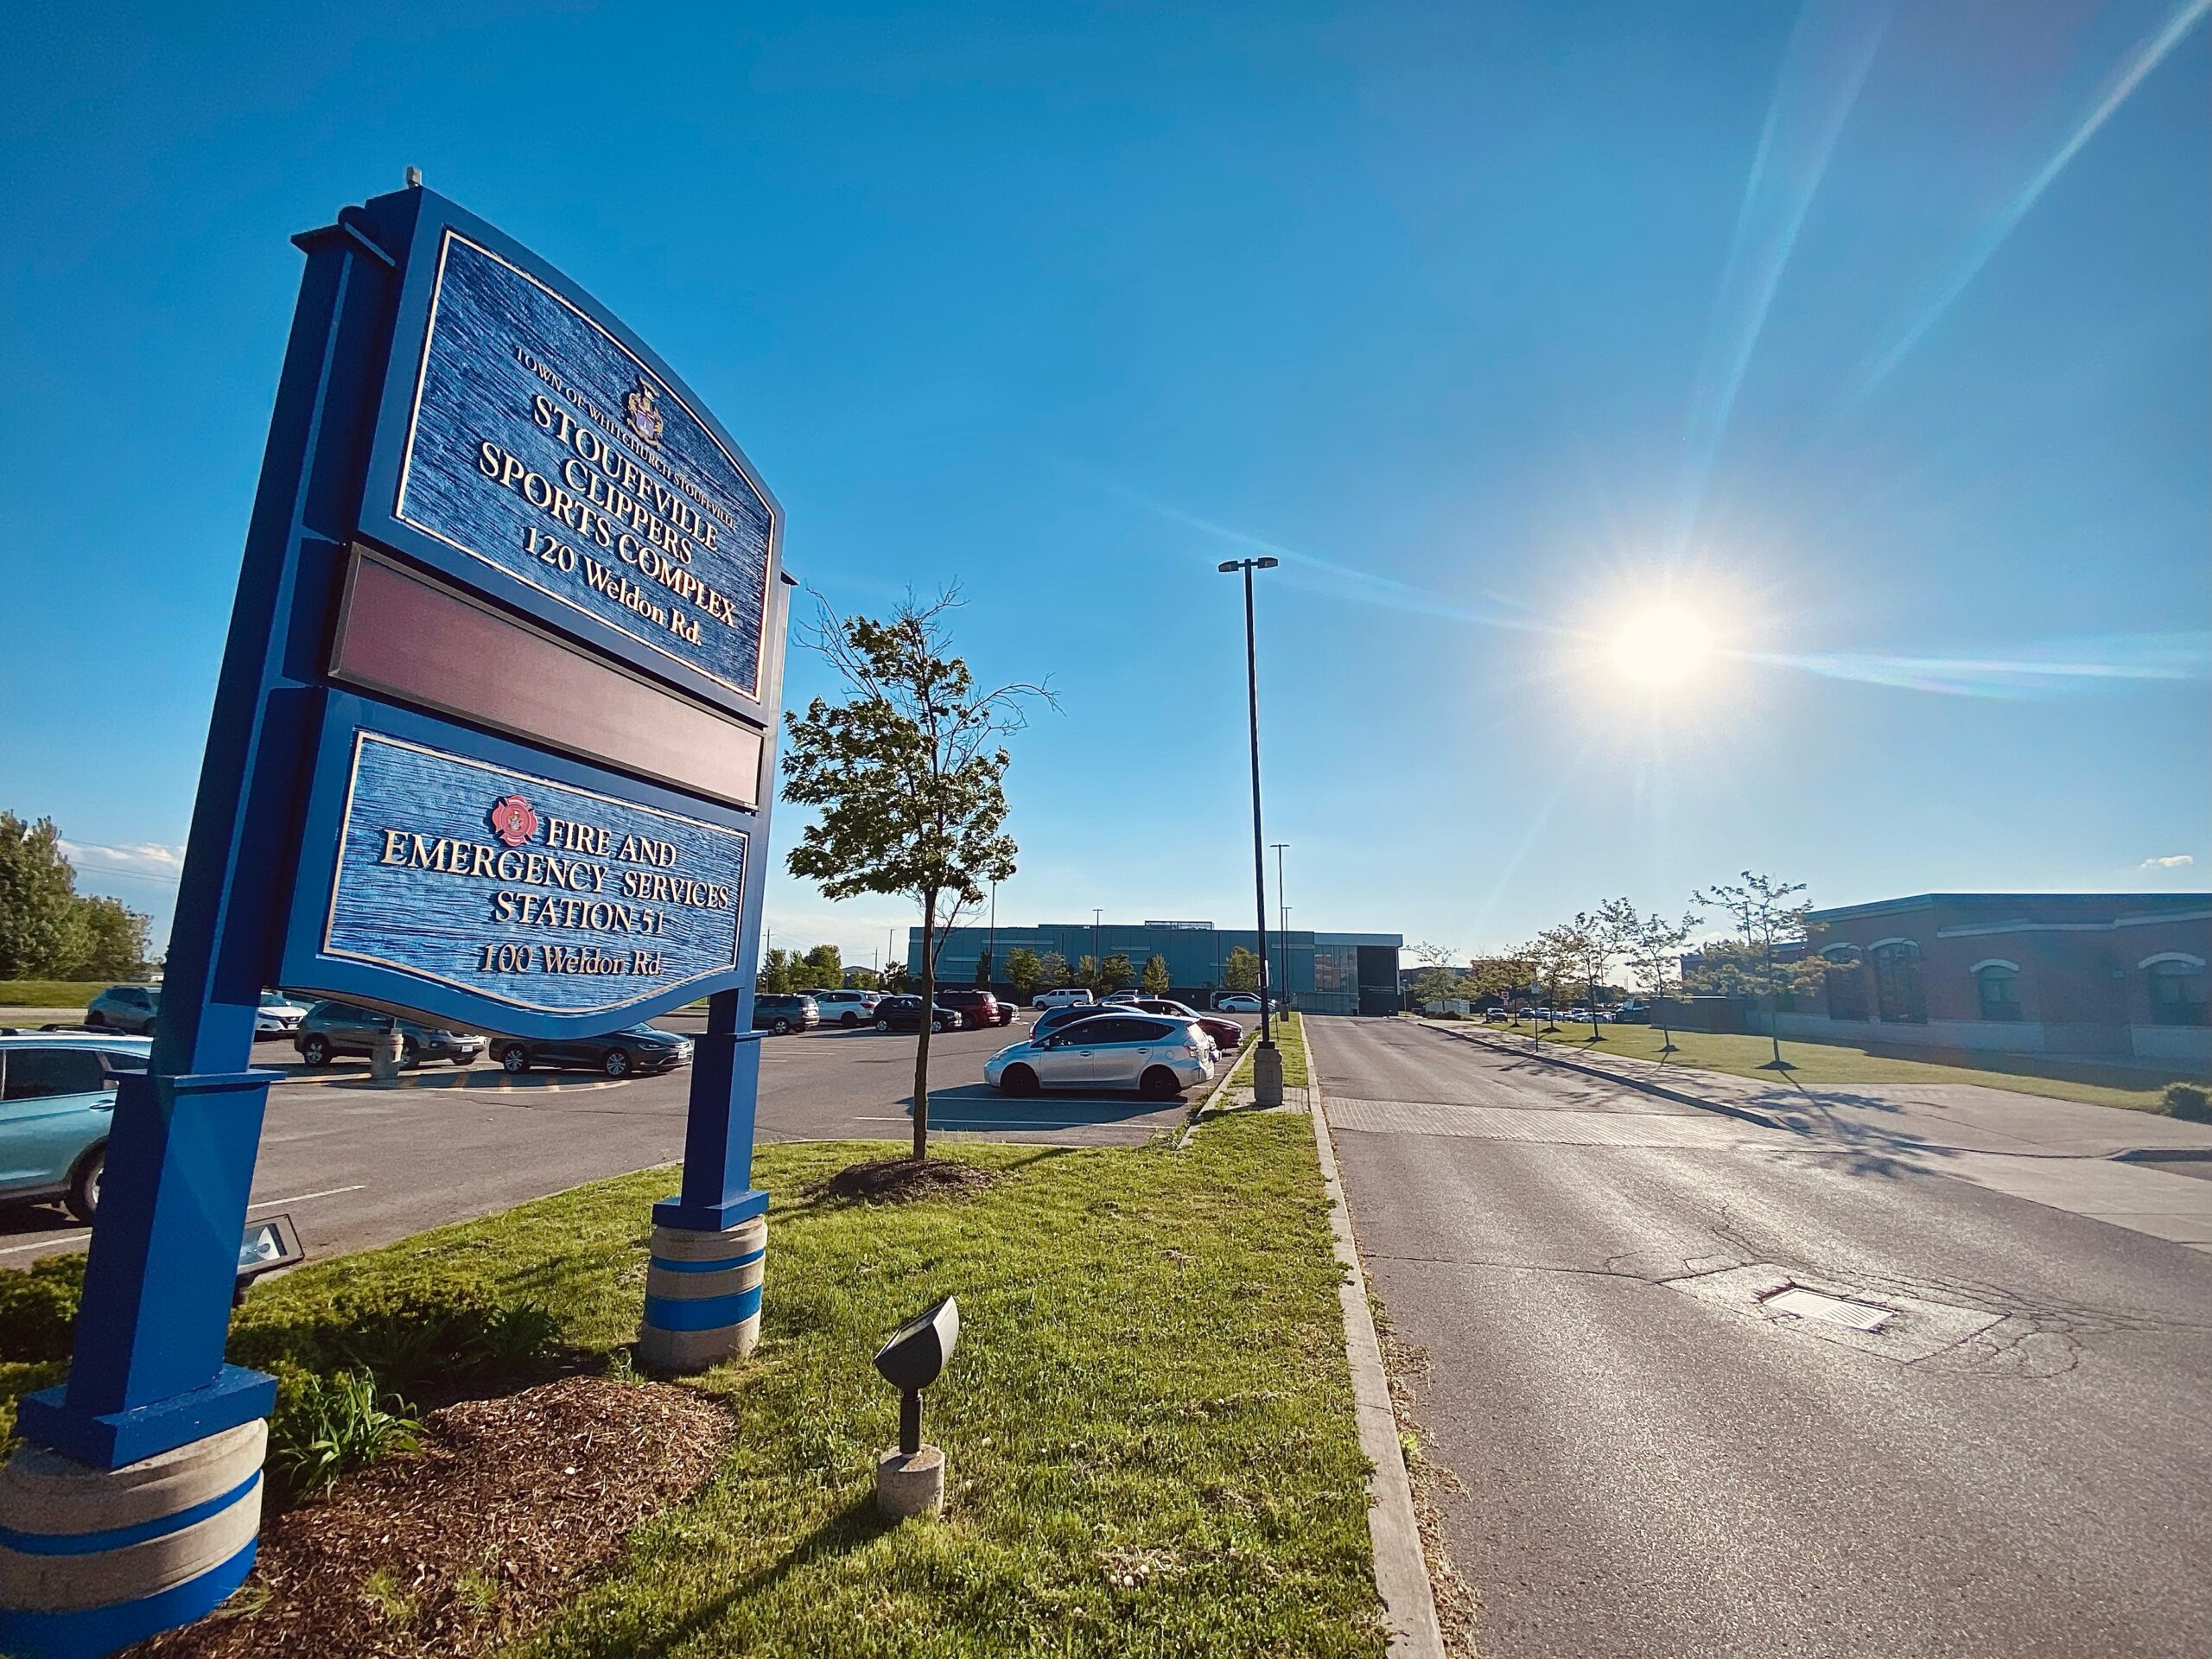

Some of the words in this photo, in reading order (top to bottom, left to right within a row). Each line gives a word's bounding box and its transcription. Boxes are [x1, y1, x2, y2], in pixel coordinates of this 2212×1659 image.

[516, 346, 562, 391] TOWN
[566, 387, 586, 409] OF
[587, 401, 671, 480] WHITCHURCH
[534, 395, 718, 551] STOUFFVILLE
[565, 459, 691, 565] CLIPPERS
[480, 442, 611, 547] SPORTS
[619, 534, 737, 627] COMPLEX
[525, 527, 575, 572] 120
[584, 556, 664, 626] Weldon
[670, 608, 702, 646] Rd.
[380, 830, 609, 892] EMERGENCY
[623, 872, 729, 908] SERVICES
[546, 818, 612, 856] FIRE
[619, 834, 676, 868] AND
[481, 943, 532, 971] 100
[543, 945, 625, 975] Weldon
[632, 950, 664, 975] Rd.
[495, 891, 632, 932] STATION
[640, 909, 664, 934] 51
